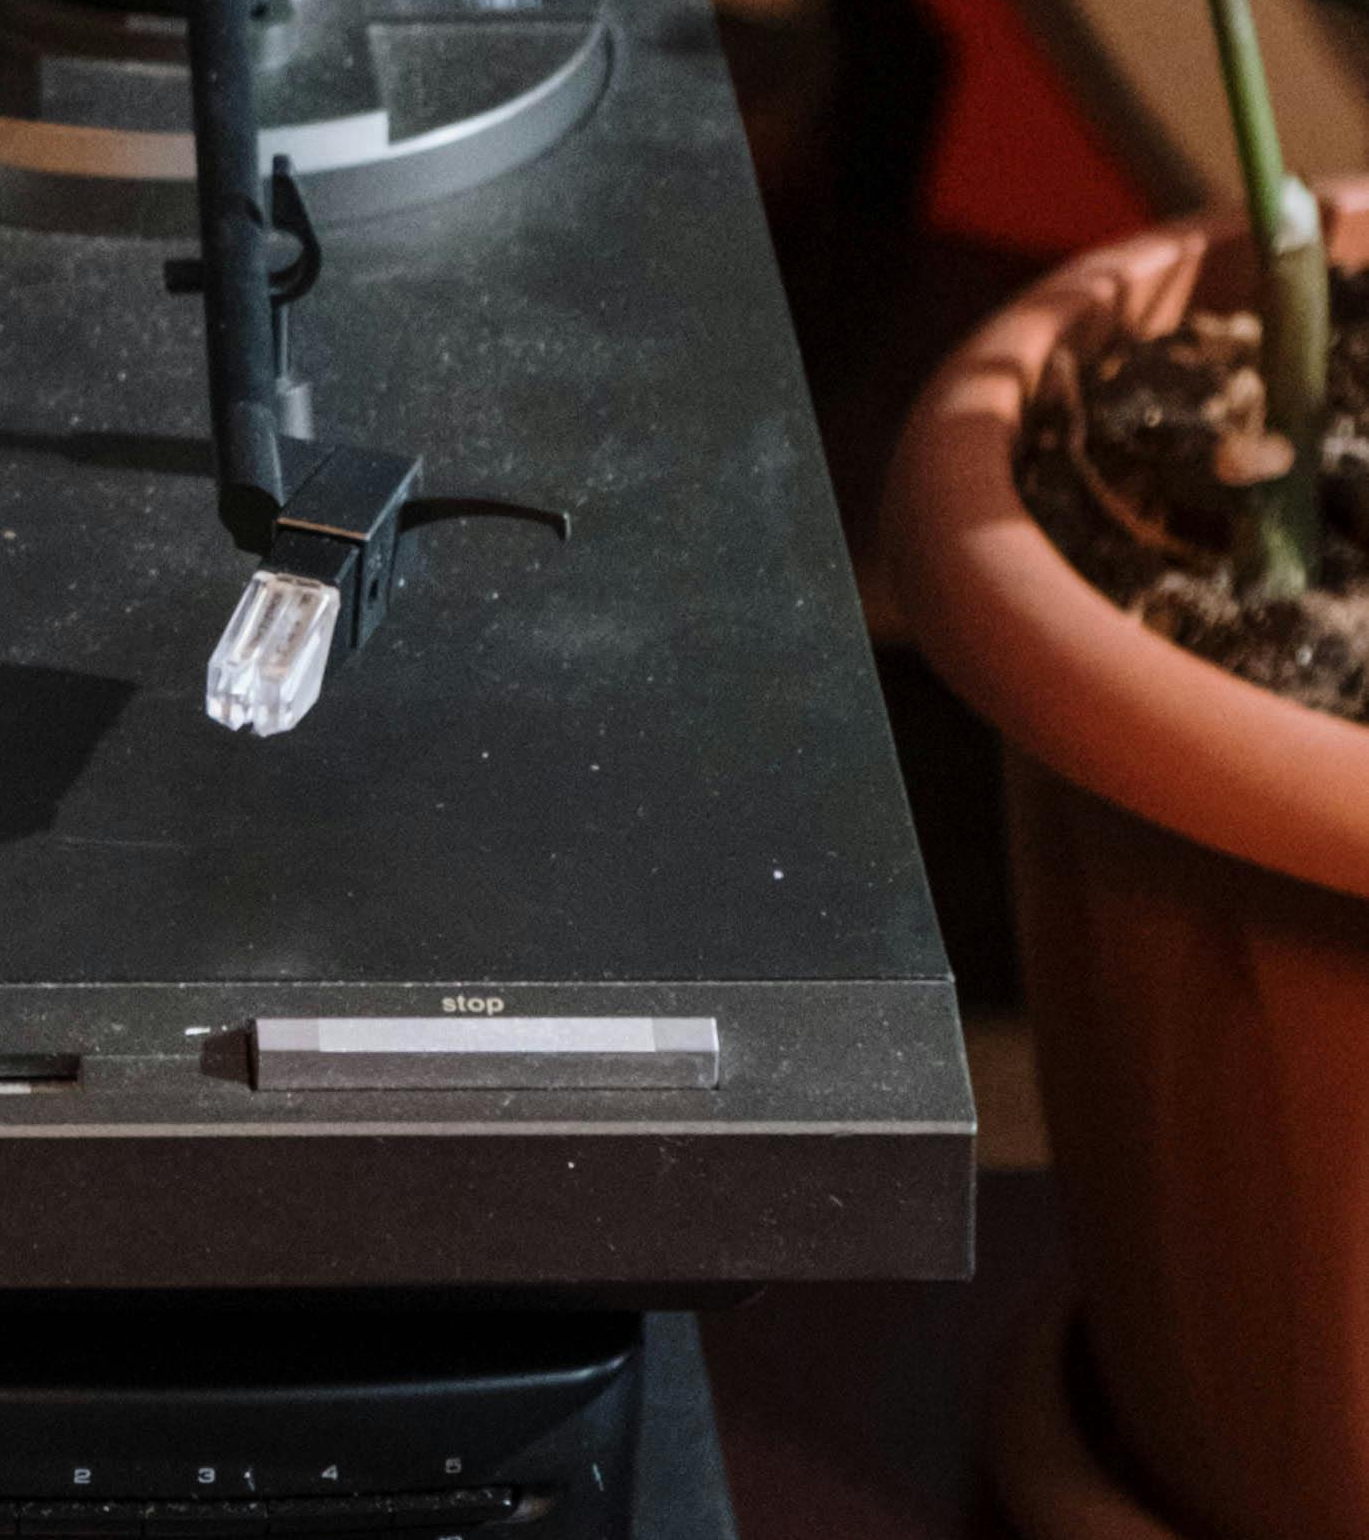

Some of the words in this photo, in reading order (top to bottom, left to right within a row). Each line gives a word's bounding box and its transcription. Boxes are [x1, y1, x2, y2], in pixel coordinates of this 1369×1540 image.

[441, 994, 505, 1017] stop
[73, 1469, 91, 1484] 2
[197, 1468, 216, 1484] 3
[321, 1465, 338, 1481] 4
